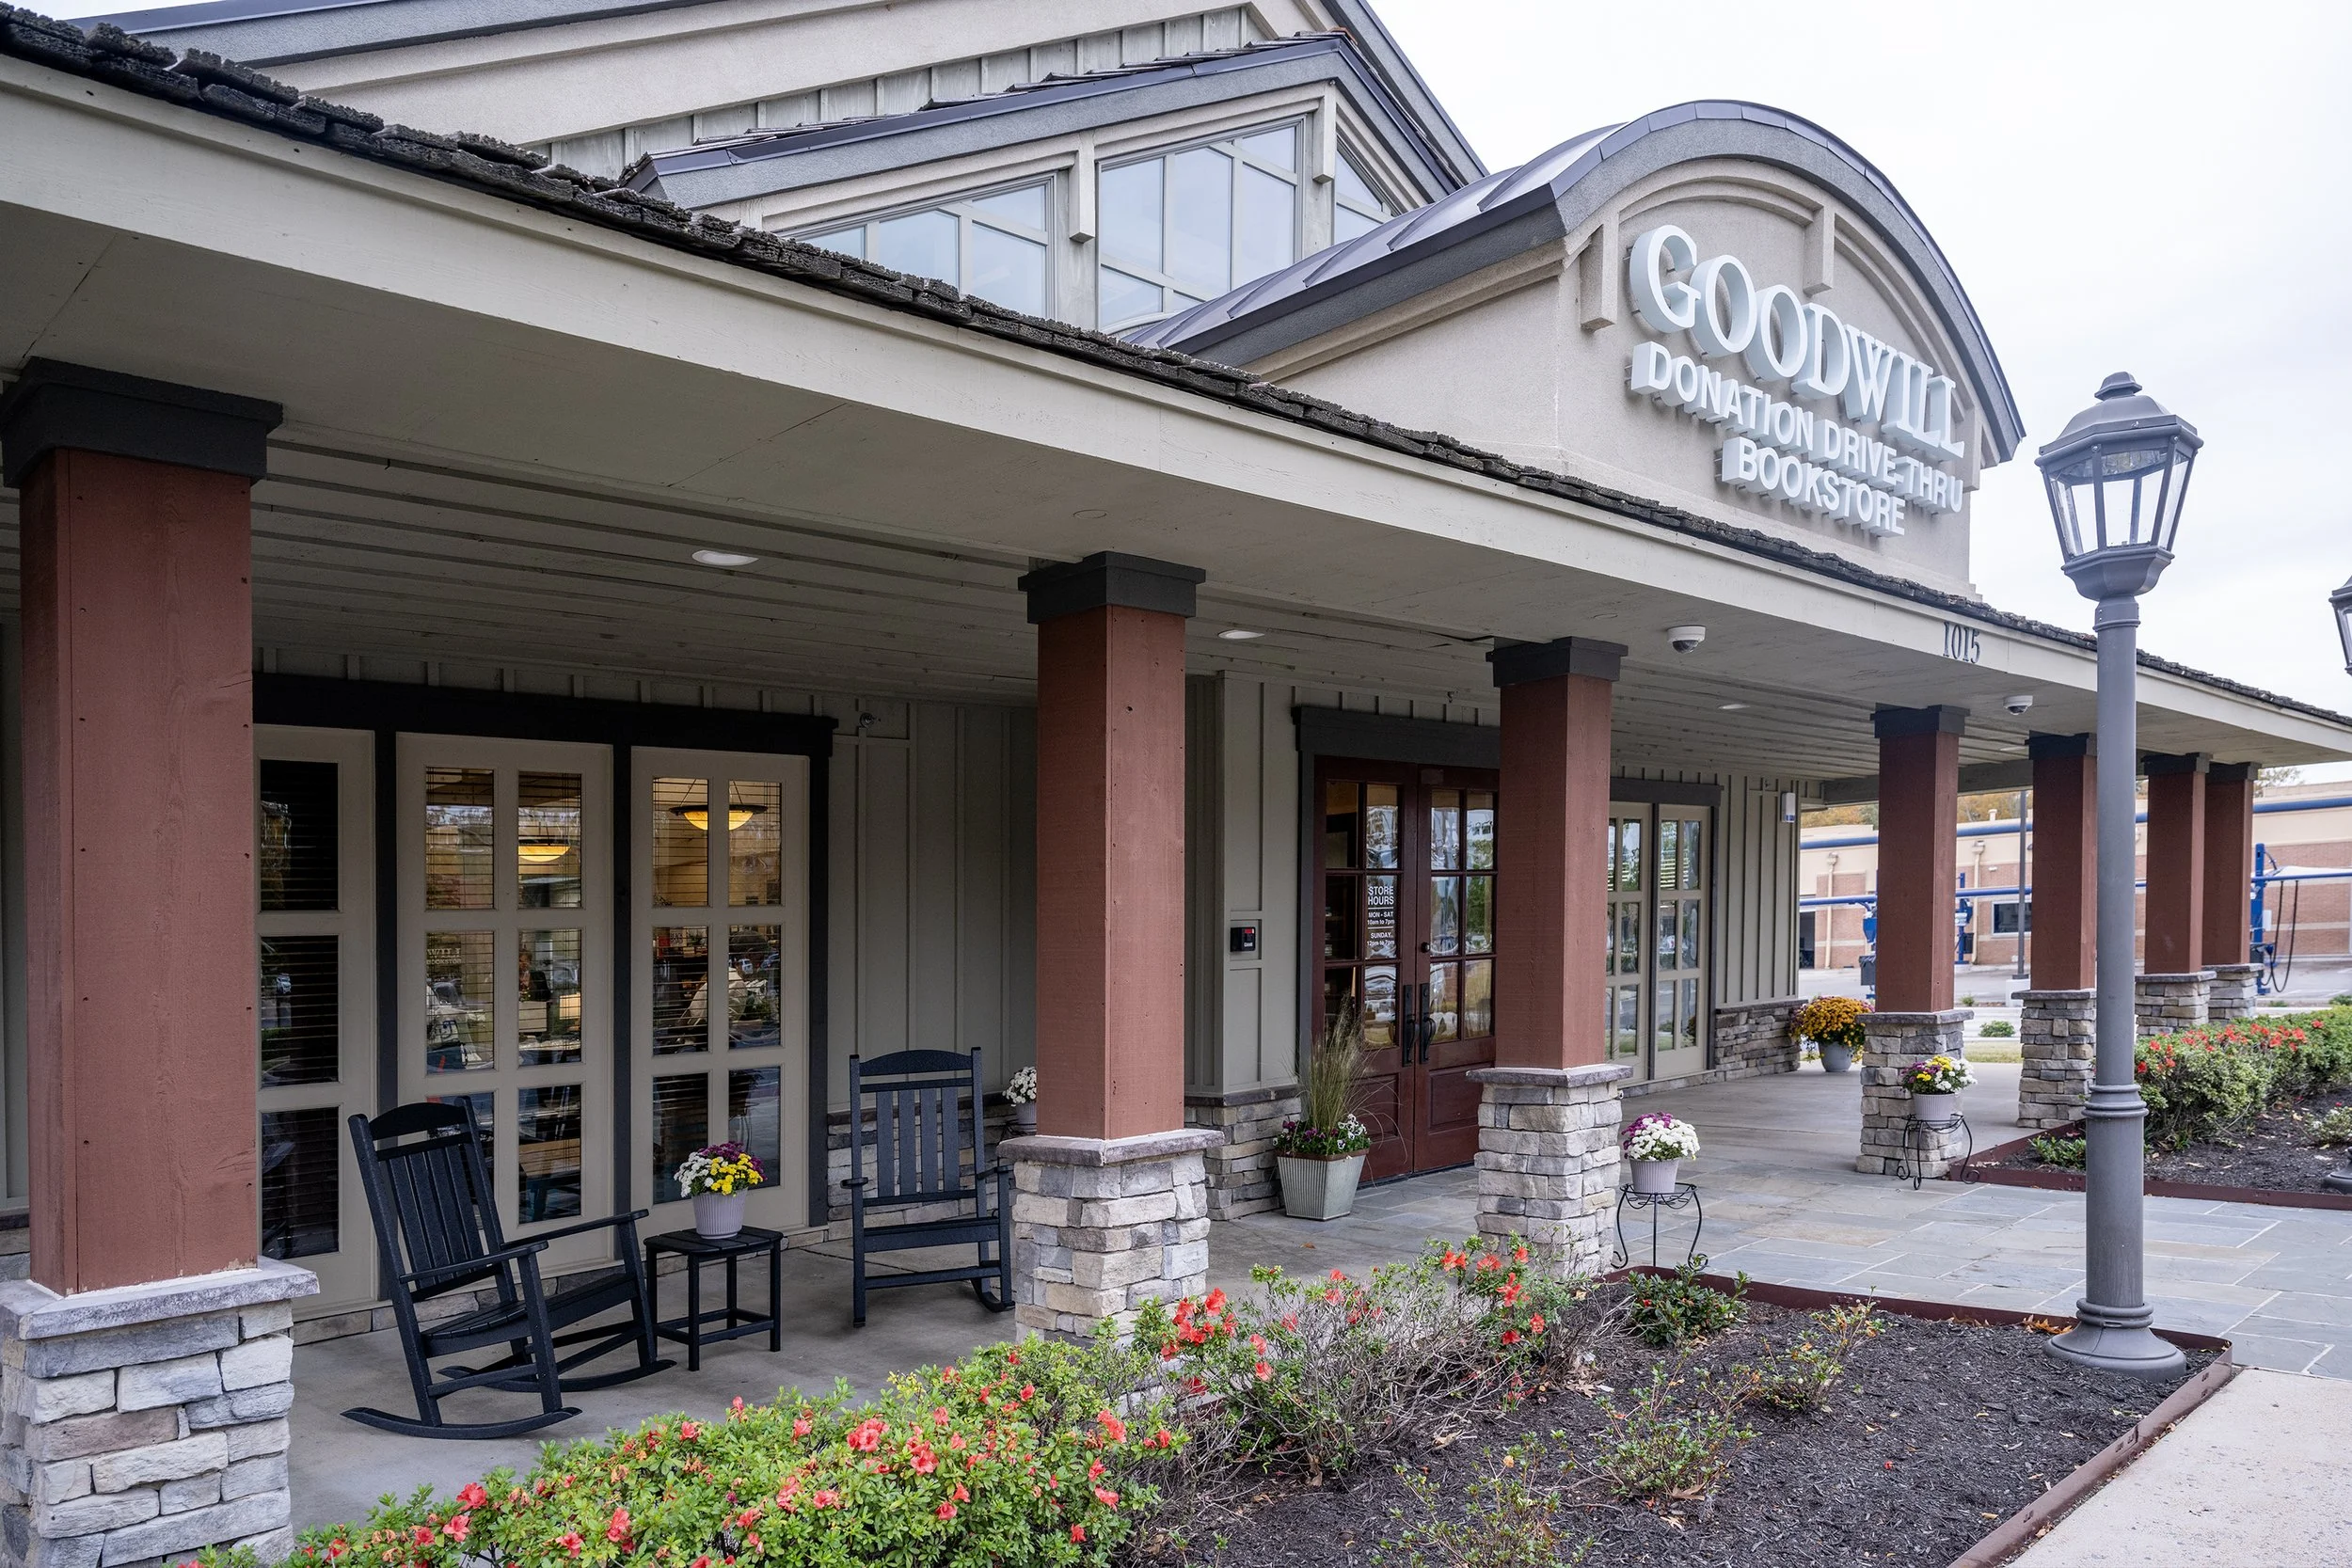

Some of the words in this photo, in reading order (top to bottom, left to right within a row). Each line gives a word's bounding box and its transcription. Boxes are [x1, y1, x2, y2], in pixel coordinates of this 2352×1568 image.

[1629, 225, 1964, 459] GOODWILL
[1631, 341, 1814, 453] DONATION
[1812, 419, 1963, 514] DRIVE-THRU
[1722, 436, 1905, 537] BOOKSTORE
[1943, 621, 1980, 664] 1015
[1367, 895, 1394, 905] HOURS
[1368, 886, 1394, 895] STORE
